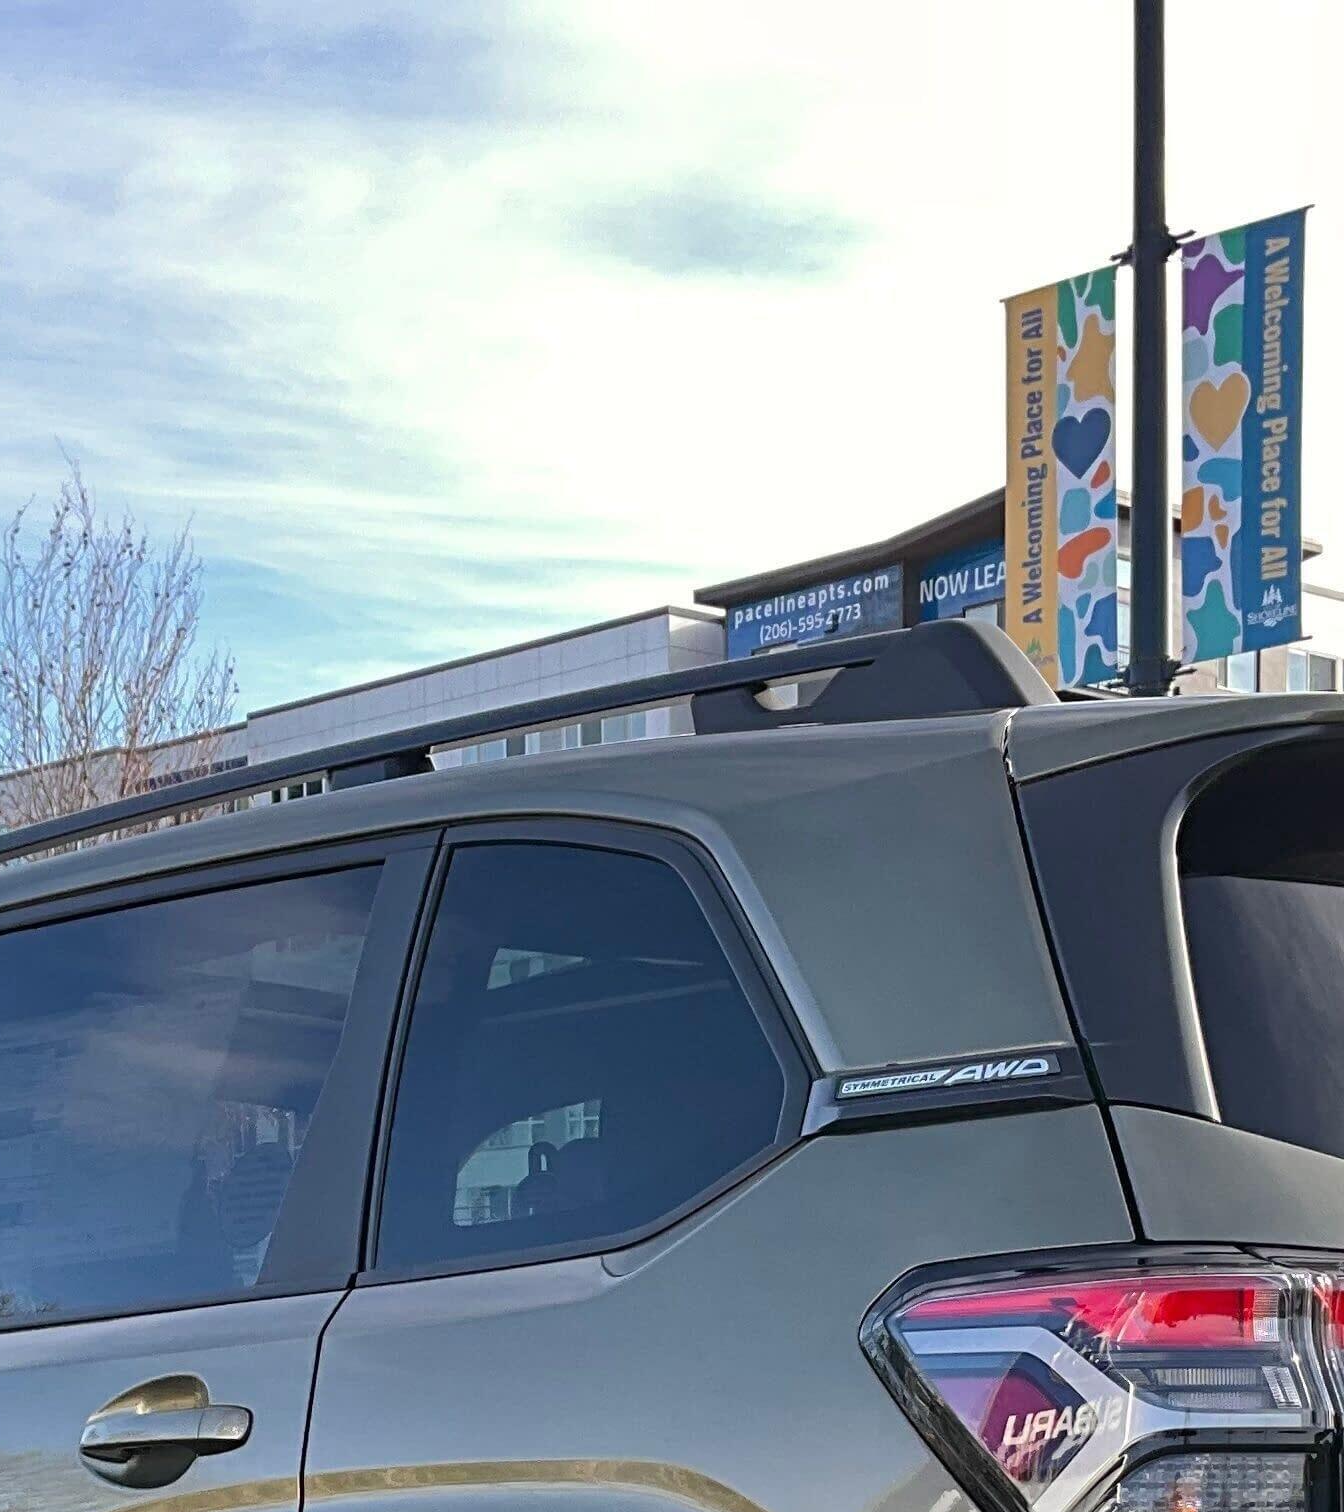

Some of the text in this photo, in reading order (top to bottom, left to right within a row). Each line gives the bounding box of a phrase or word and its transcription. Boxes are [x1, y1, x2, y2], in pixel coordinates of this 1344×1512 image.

[1256, 236, 1290, 580] A Welcoming Place for All
[1021, 307, 1047, 623] A Welcoming Place for All
[734, 574, 890, 629] pacelineapts.com
[919, 571, 969, 604] NOW
[842, 1058, 1050, 1094] SYMMETRICAL AWD
